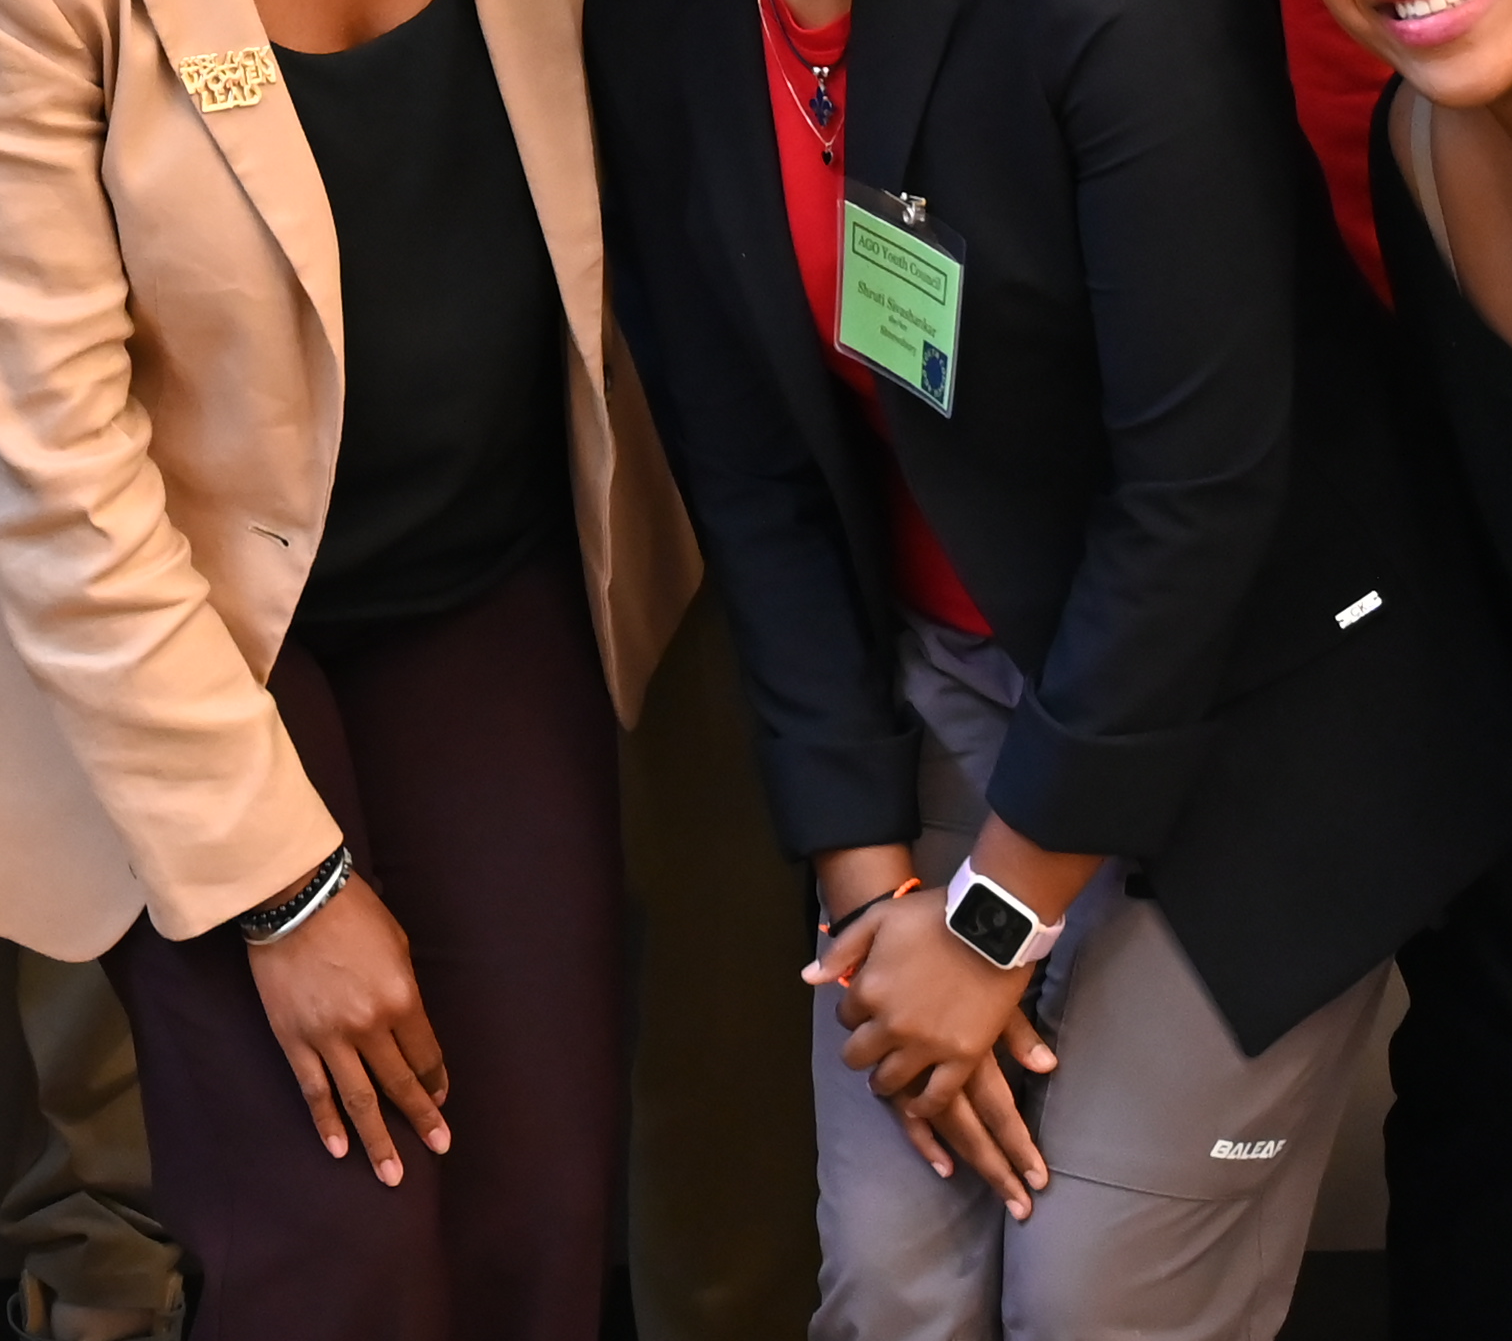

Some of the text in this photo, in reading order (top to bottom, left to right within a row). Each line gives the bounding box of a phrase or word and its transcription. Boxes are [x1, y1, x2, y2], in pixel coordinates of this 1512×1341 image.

[858, 234, 942, 292] AGO Youth Council
[1209, 1139, 1287, 1160] BALEAF
